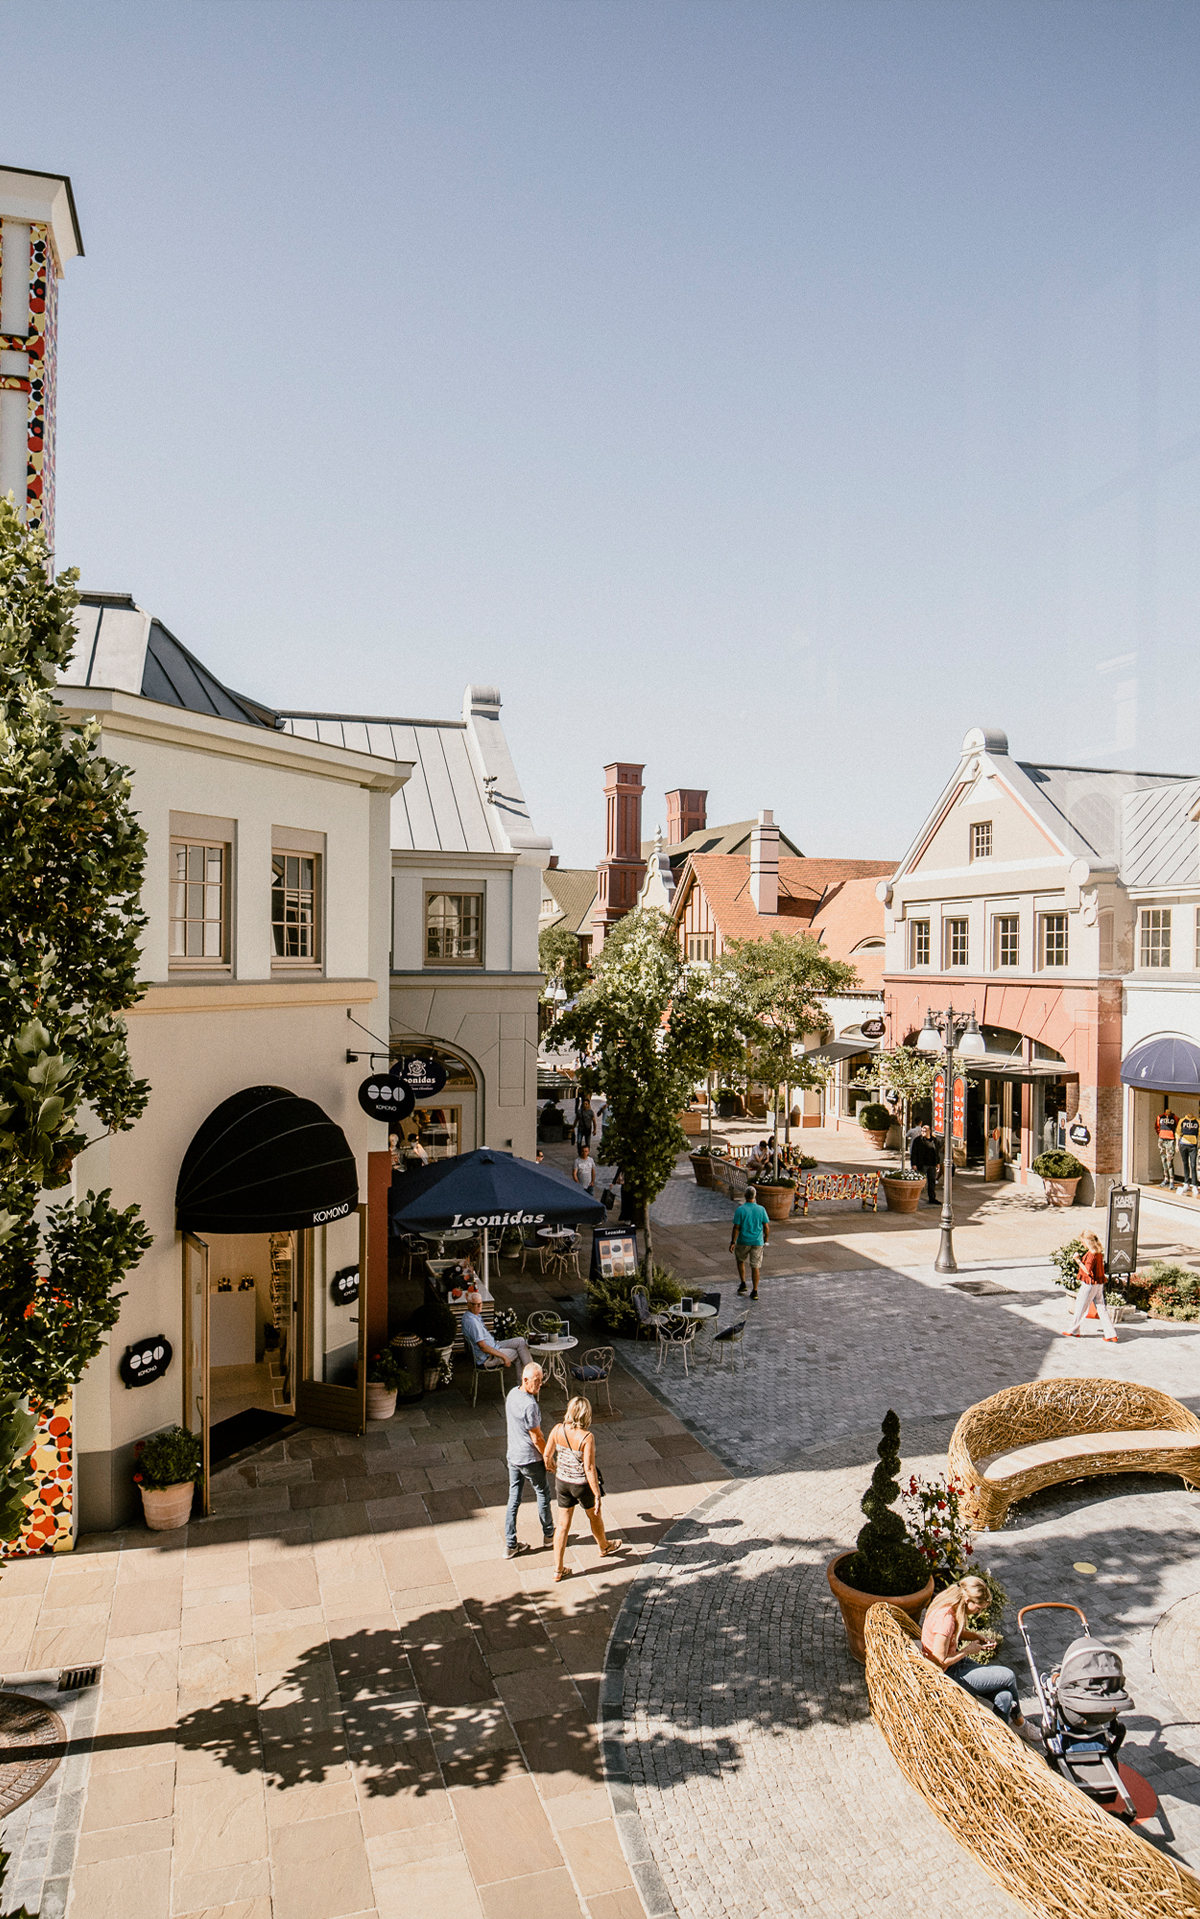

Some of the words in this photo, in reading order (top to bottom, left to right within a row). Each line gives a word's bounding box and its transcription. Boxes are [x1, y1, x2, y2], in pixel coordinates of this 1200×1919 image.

[375, 1104, 397, 1112] KOMONO
[313, 1203, 349, 1223] KOMONO
[451, 1209, 545, 1228] Leonidas
[137, 1365, 158, 1377] KOMONO
